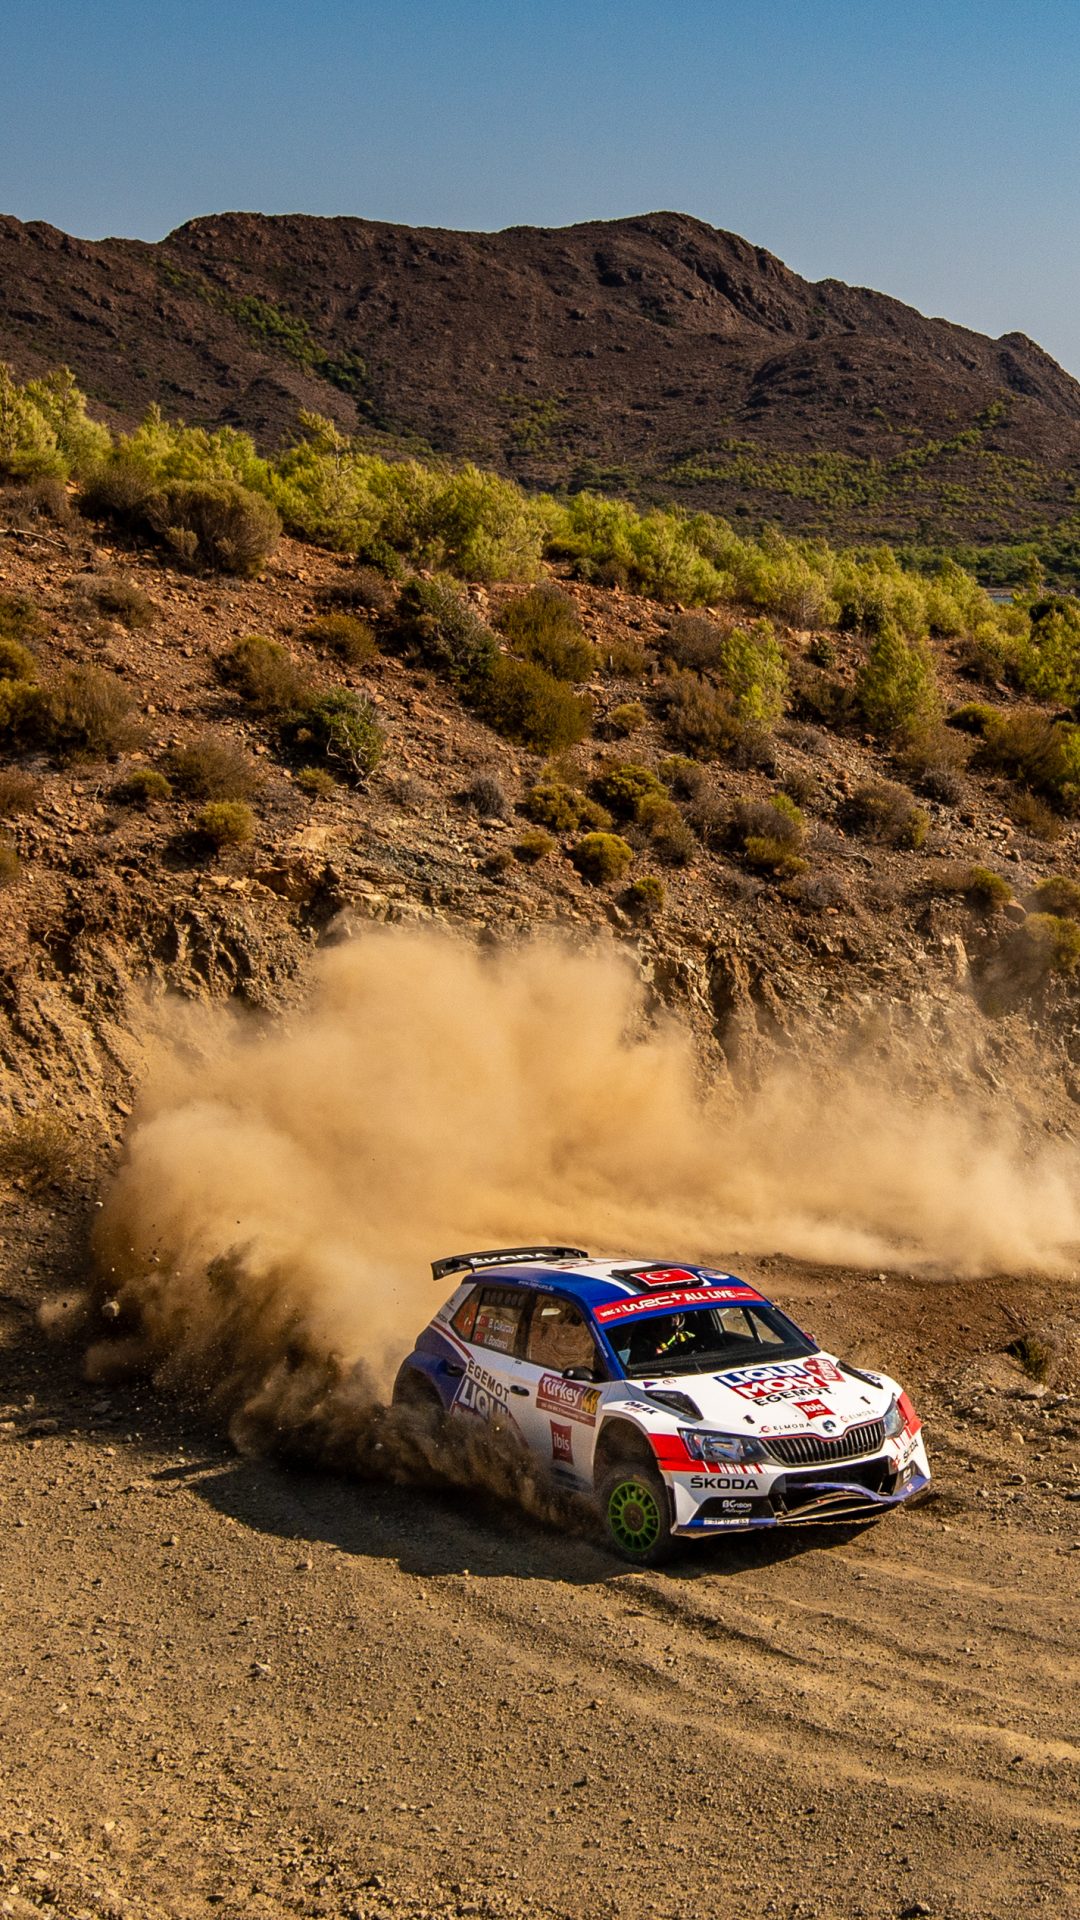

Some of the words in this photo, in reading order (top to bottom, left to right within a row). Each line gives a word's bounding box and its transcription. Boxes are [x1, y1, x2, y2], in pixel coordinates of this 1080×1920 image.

[684, 1292, 707, 1302] ALL
[708, 1290, 736, 1300] LIVE
[467, 1360, 510, 1402] EGEMOT
[718, 1364, 809, 1387] LIQUI
[542, 1377, 581, 1407] Turkey
[735, 1375, 822, 1399] MOLY
[752, 1387, 833, 1407] EGEMOT
[799, 1401, 826, 1413] ibis
[553, 1432, 570, 1451] ibis
[690, 1475, 759, 1490] ŠKODA
